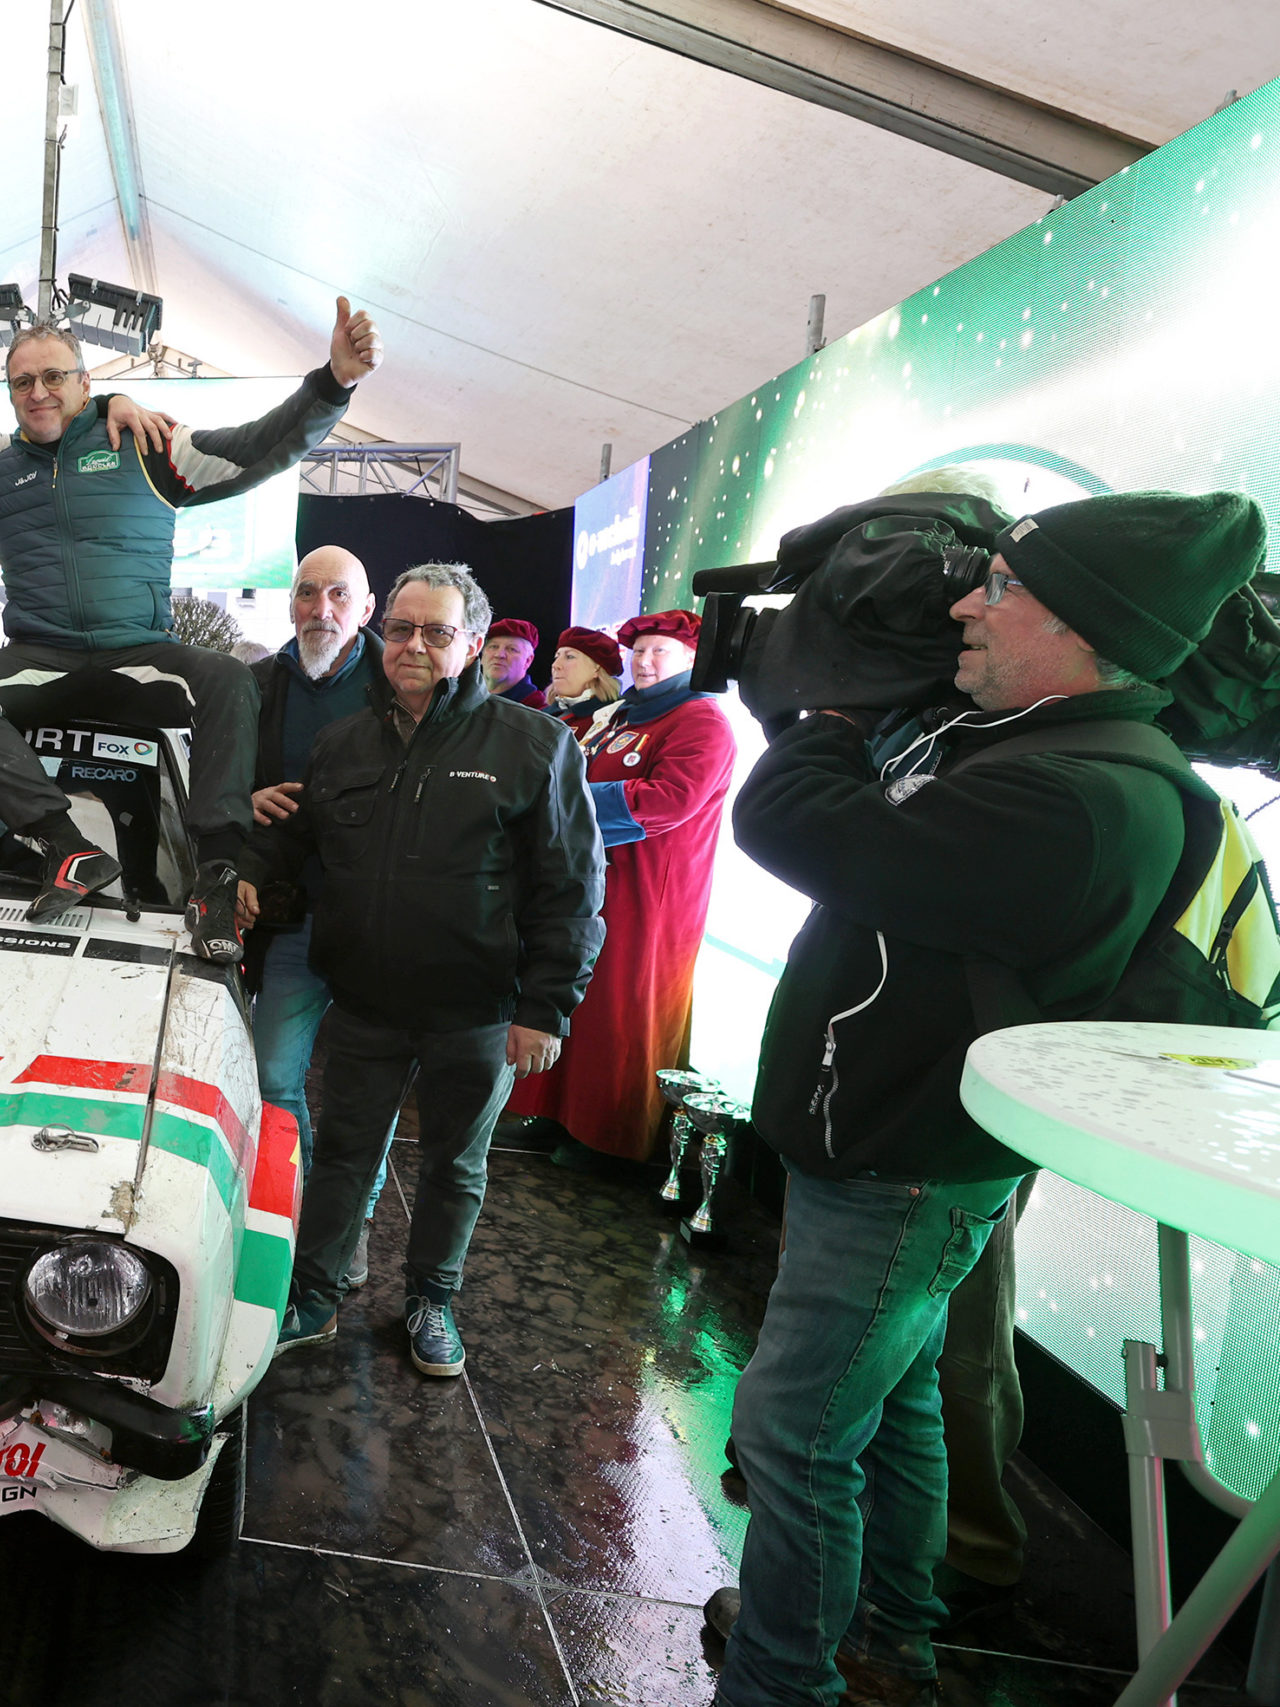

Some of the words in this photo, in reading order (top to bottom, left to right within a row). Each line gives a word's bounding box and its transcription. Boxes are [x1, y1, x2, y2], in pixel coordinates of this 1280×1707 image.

[98, 741, 129, 755] FOX
[72, 766, 137, 782] RECARO
[456, 771, 490, 781] VENTURE
